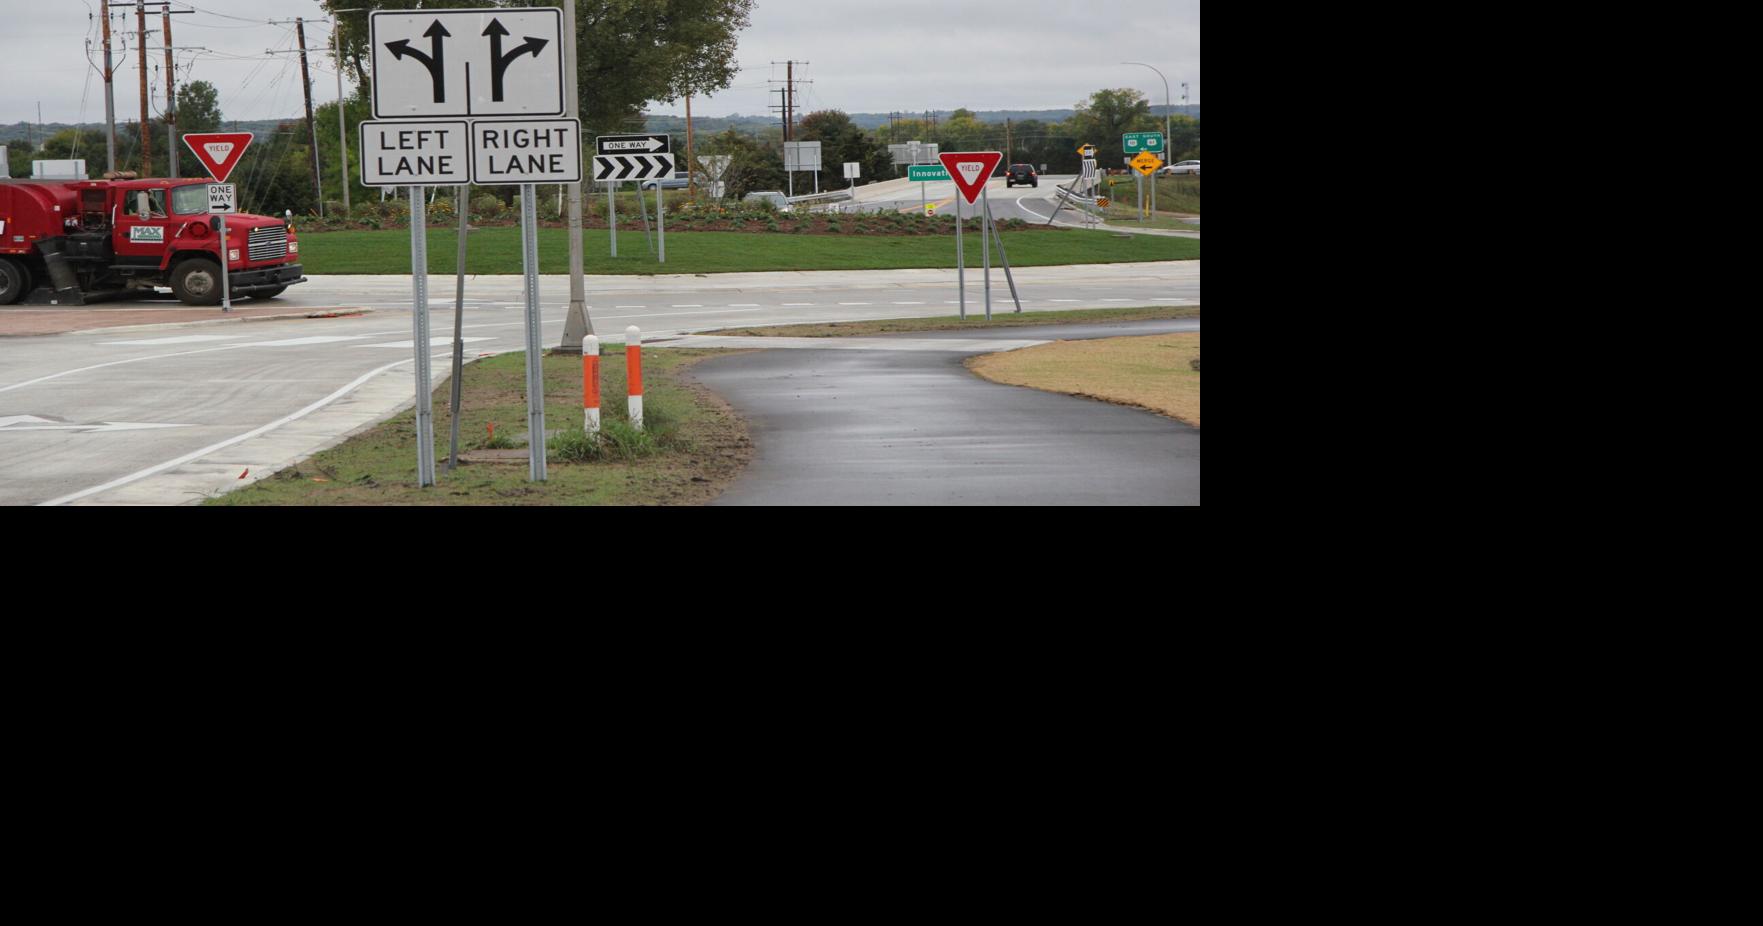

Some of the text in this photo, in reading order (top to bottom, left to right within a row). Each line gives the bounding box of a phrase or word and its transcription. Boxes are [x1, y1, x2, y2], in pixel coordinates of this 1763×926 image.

[380, 130, 449, 150] LEFT
[482, 128, 568, 149] RIGHT
[378, 155, 454, 175] LANE
[489, 154, 565, 174] LANE
[961, 164, 980, 172] YIELD
[210, 185, 232, 194] ONE
[210, 194, 232, 202] WAY
[133, 227, 162, 238] MAX
